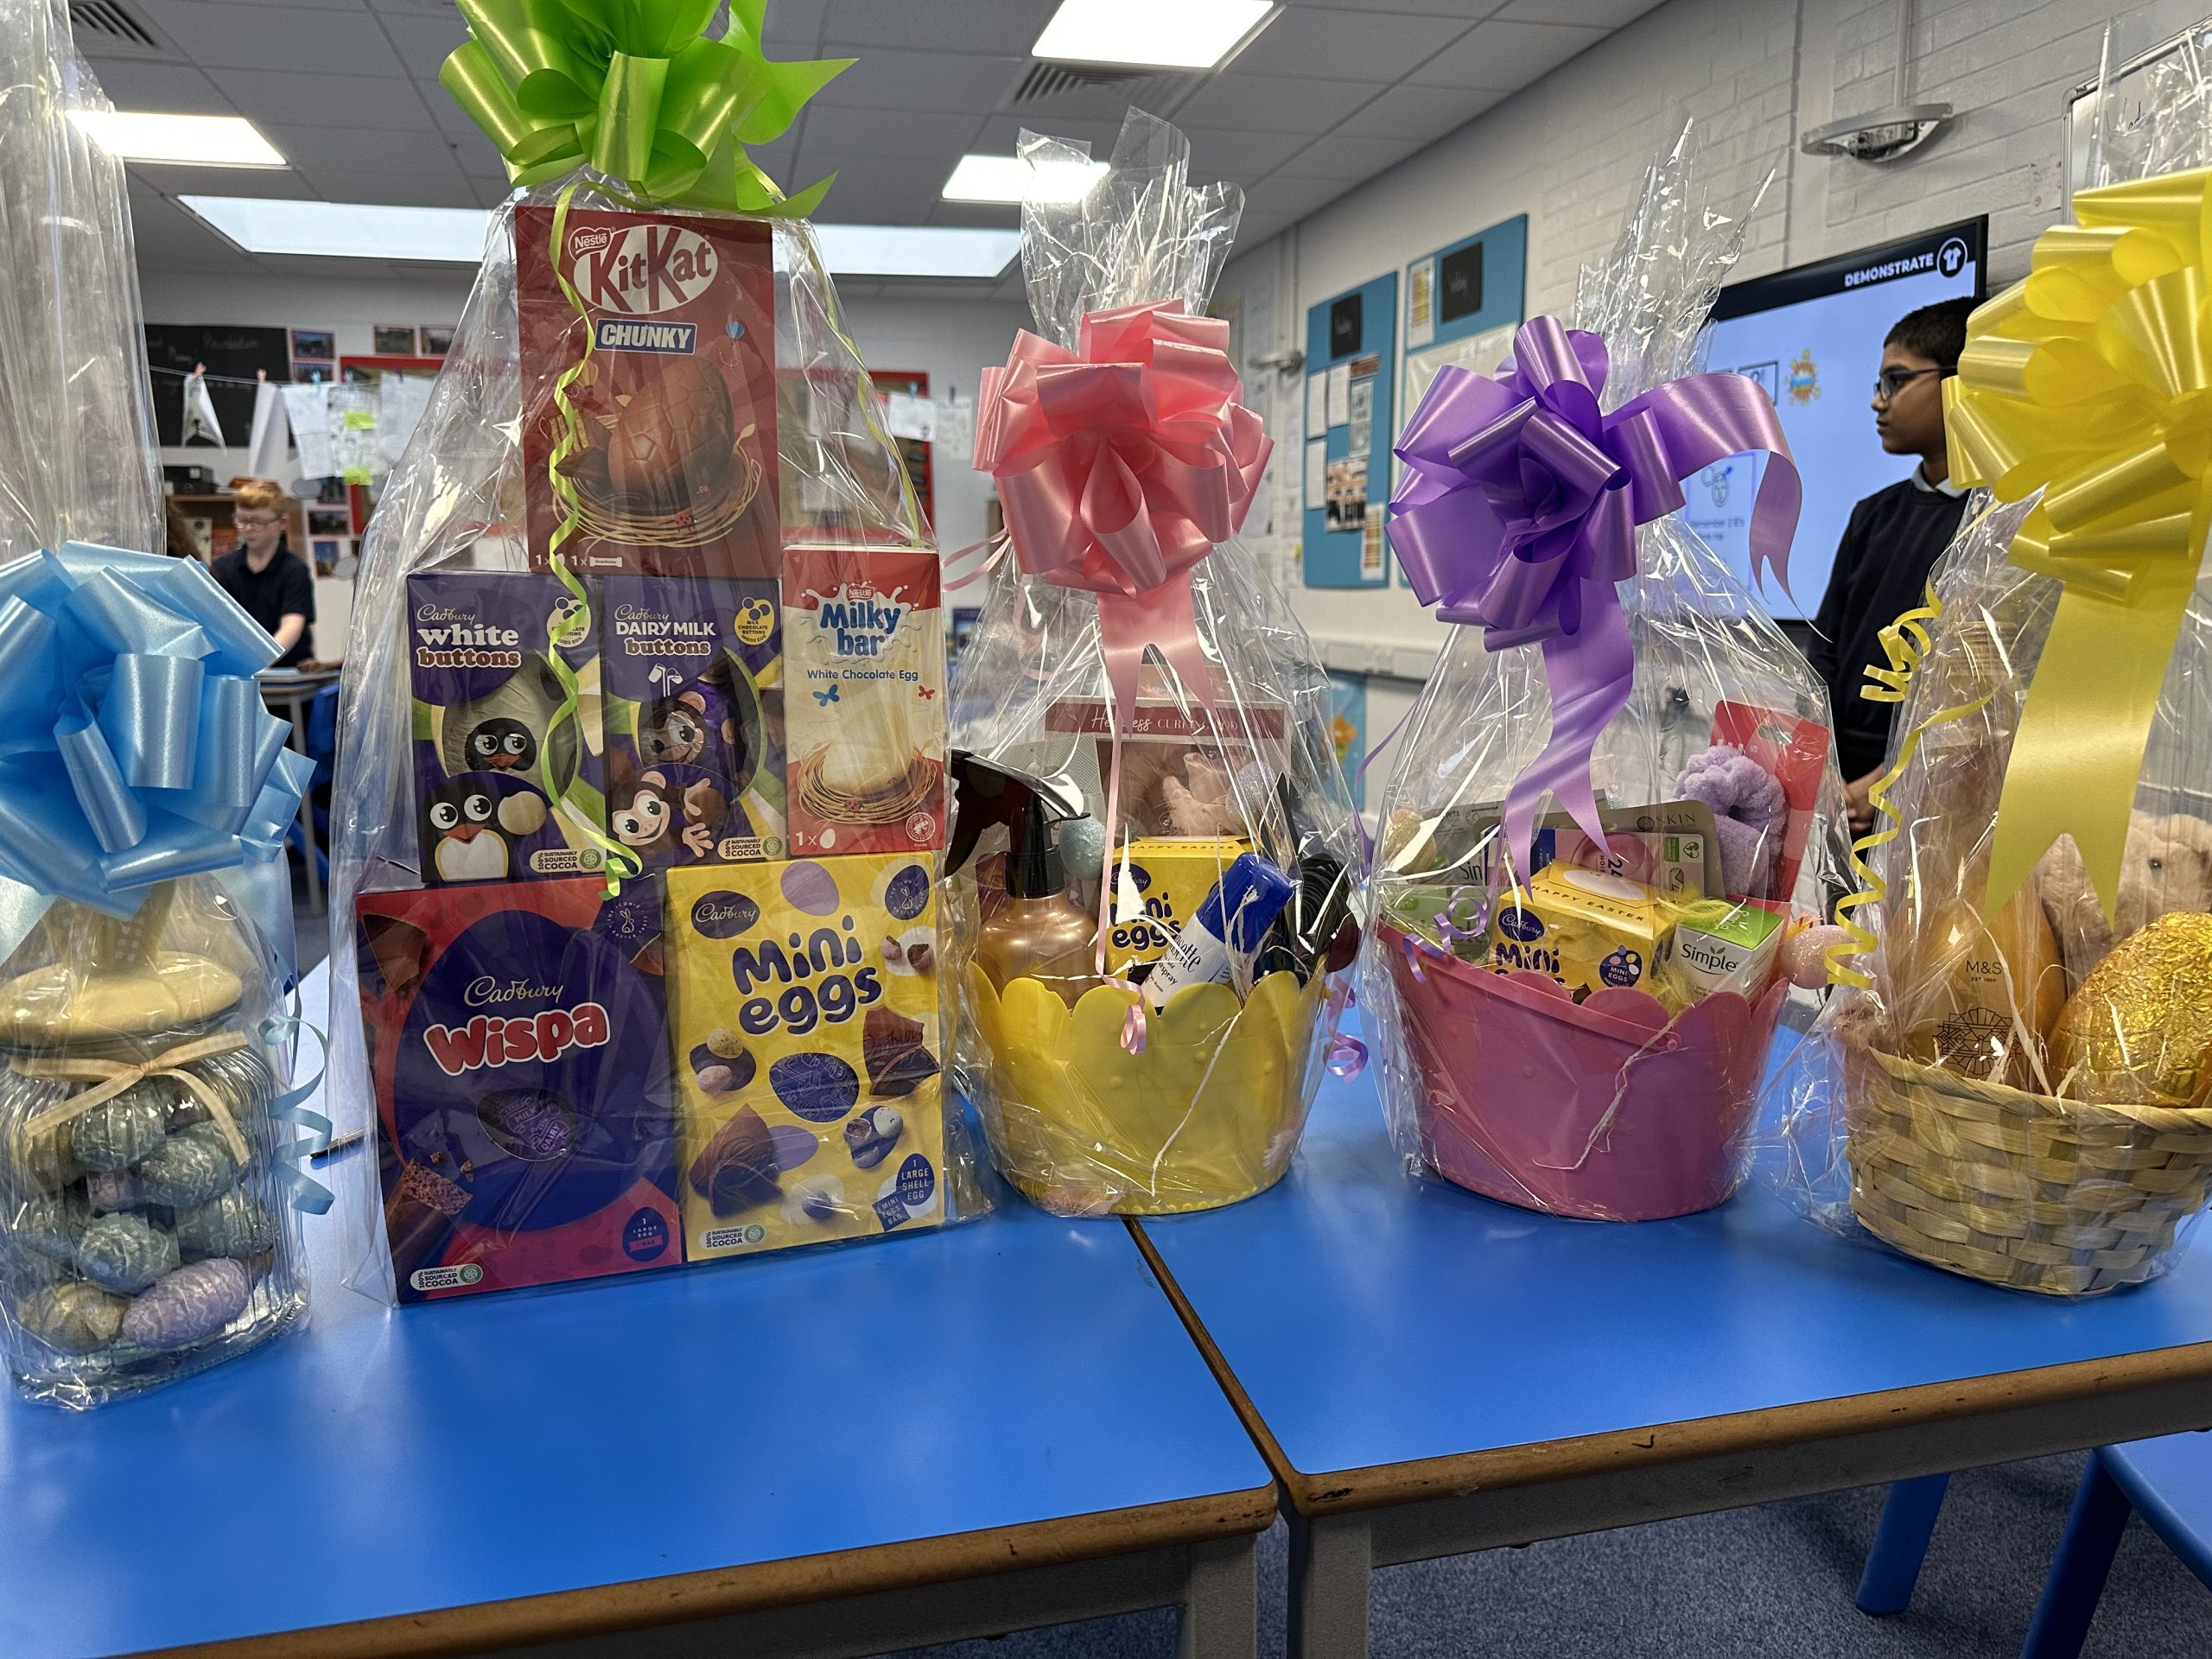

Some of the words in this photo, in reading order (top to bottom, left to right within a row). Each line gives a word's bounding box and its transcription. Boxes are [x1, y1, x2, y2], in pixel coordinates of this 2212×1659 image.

[589, 226, 712, 313] KitKat
[1844, 252, 1935, 288] DEMONSTRATE
[601, 323, 692, 349] CHUNKY
[536, 554, 542, 566] 1
[571, 555, 578, 566] 1
[416, 603, 476, 624] Cadbury
[614, 603, 670, 621] Cadbury
[820, 600, 902, 634] Milky
[416, 623, 519, 646] white
[615, 621, 672, 637] DAIRY
[673, 622, 717, 636] MILK
[624, 638, 711, 656] buttons
[836, 627, 886, 657] bar
[416, 646, 522, 668] buttons
[807, 670, 839, 680] White
[842, 670, 895, 680] Chocolate
[899, 671, 918, 682] Egg
[795, 830, 804, 846] 1
[1532, 885, 1580, 901] HAPPY
[1586, 901, 1645, 922] EASTER
[695, 902, 760, 924] Cadbury
[1502, 912, 1542, 939] Cadbury
[732, 914, 862, 995] Mini
[1496, 942, 1560, 974] Mini
[1681, 944, 1737, 973] Simple
[1610, 966, 1628, 976] MINI
[1966, 960, 2002, 975] M&S
[1608, 972, 1628, 982] EGGS
[464, 976, 564, 1007] Cadbury
[739, 966, 882, 1036] eggs
[423, 1002, 610, 1077] Wispa
[912, 1159, 917, 1168] 1
[901, 1167, 929, 1180] LARGE
[902, 1179, 929, 1191] SHELL
[881, 1196, 899, 1210] MINI
[907, 1190, 925, 1201] EGG
[882, 1205, 901, 1218] EGGS
[632, 1225, 657, 1234] LARGE
[711, 1227, 743, 1236] SUSTAINABLY
[712, 1232, 743, 1241] SOURCED
[712, 1238, 743, 1247] COCOA
[424, 1279, 458, 1287] COCOA
